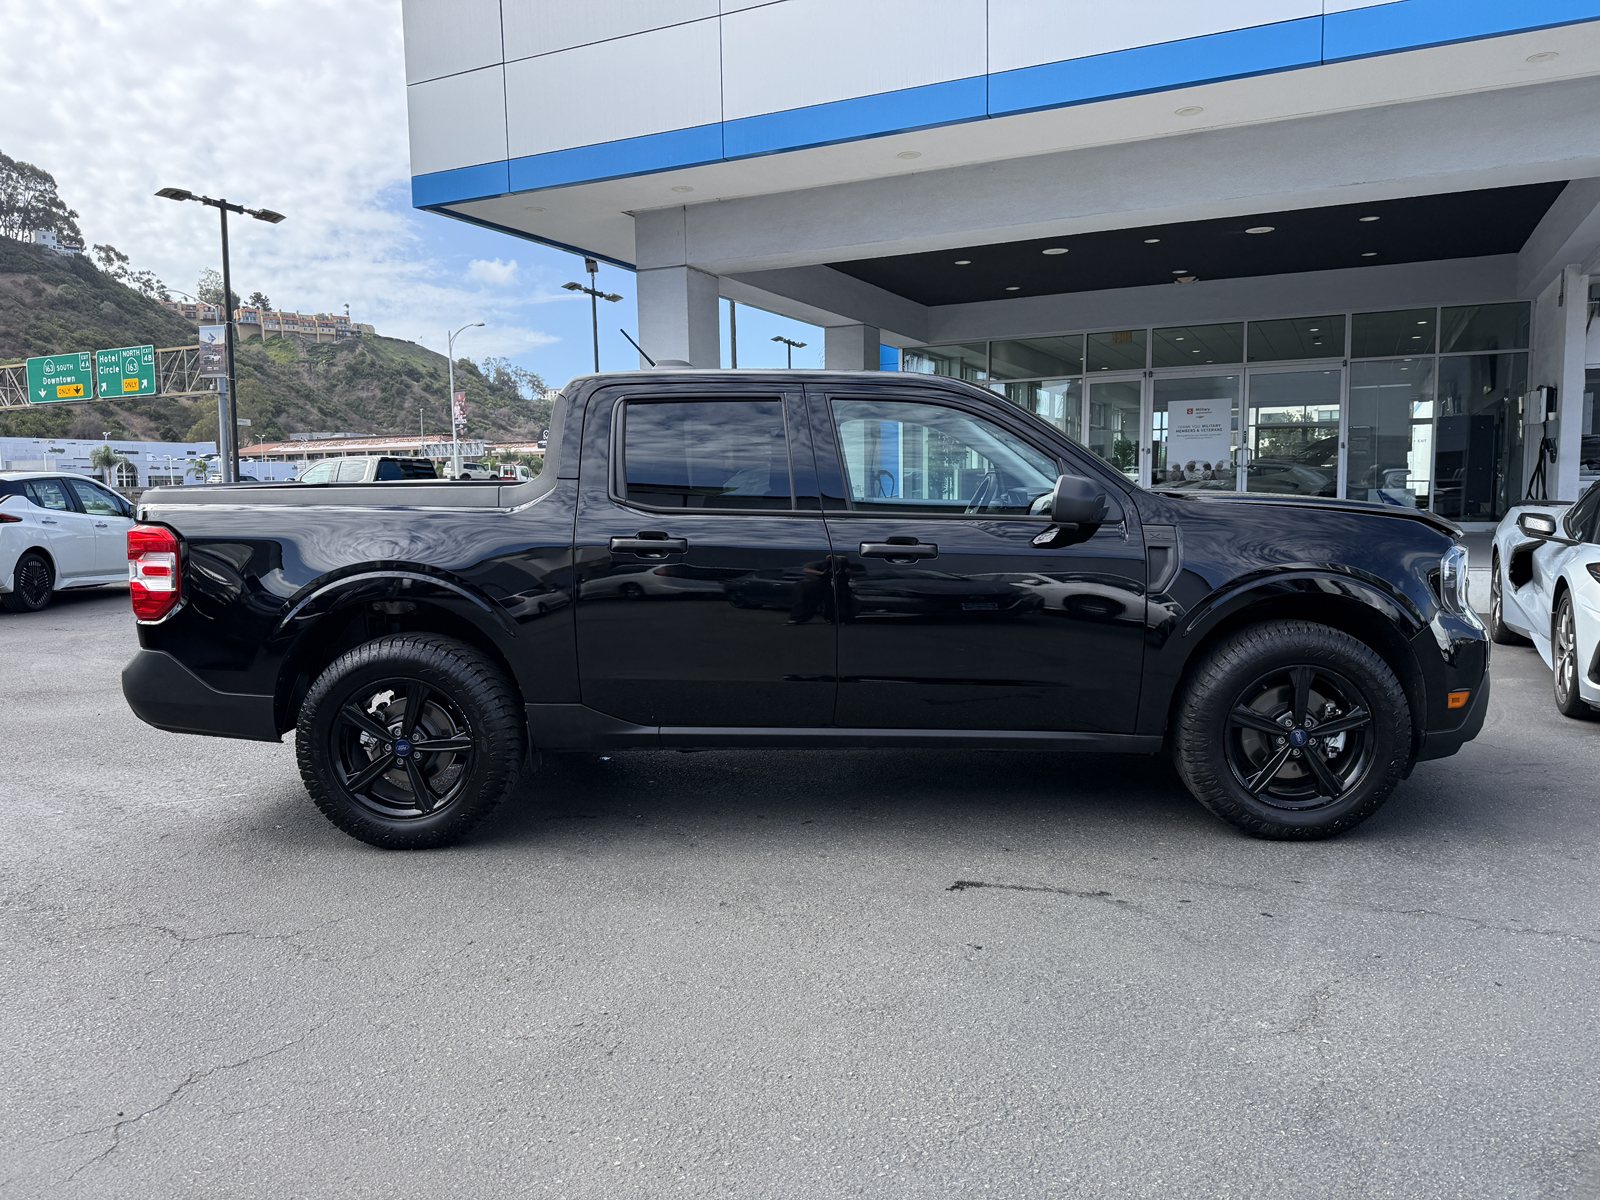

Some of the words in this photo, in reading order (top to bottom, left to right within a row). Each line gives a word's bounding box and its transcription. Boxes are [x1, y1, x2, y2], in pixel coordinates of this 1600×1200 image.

[99, 354, 118, 363] Hotel
[46, 364, 54, 372] 163
[99, 366, 119, 374] Circle
[128, 363, 137, 371] 163
[43, 376, 76, 385] Downtown
